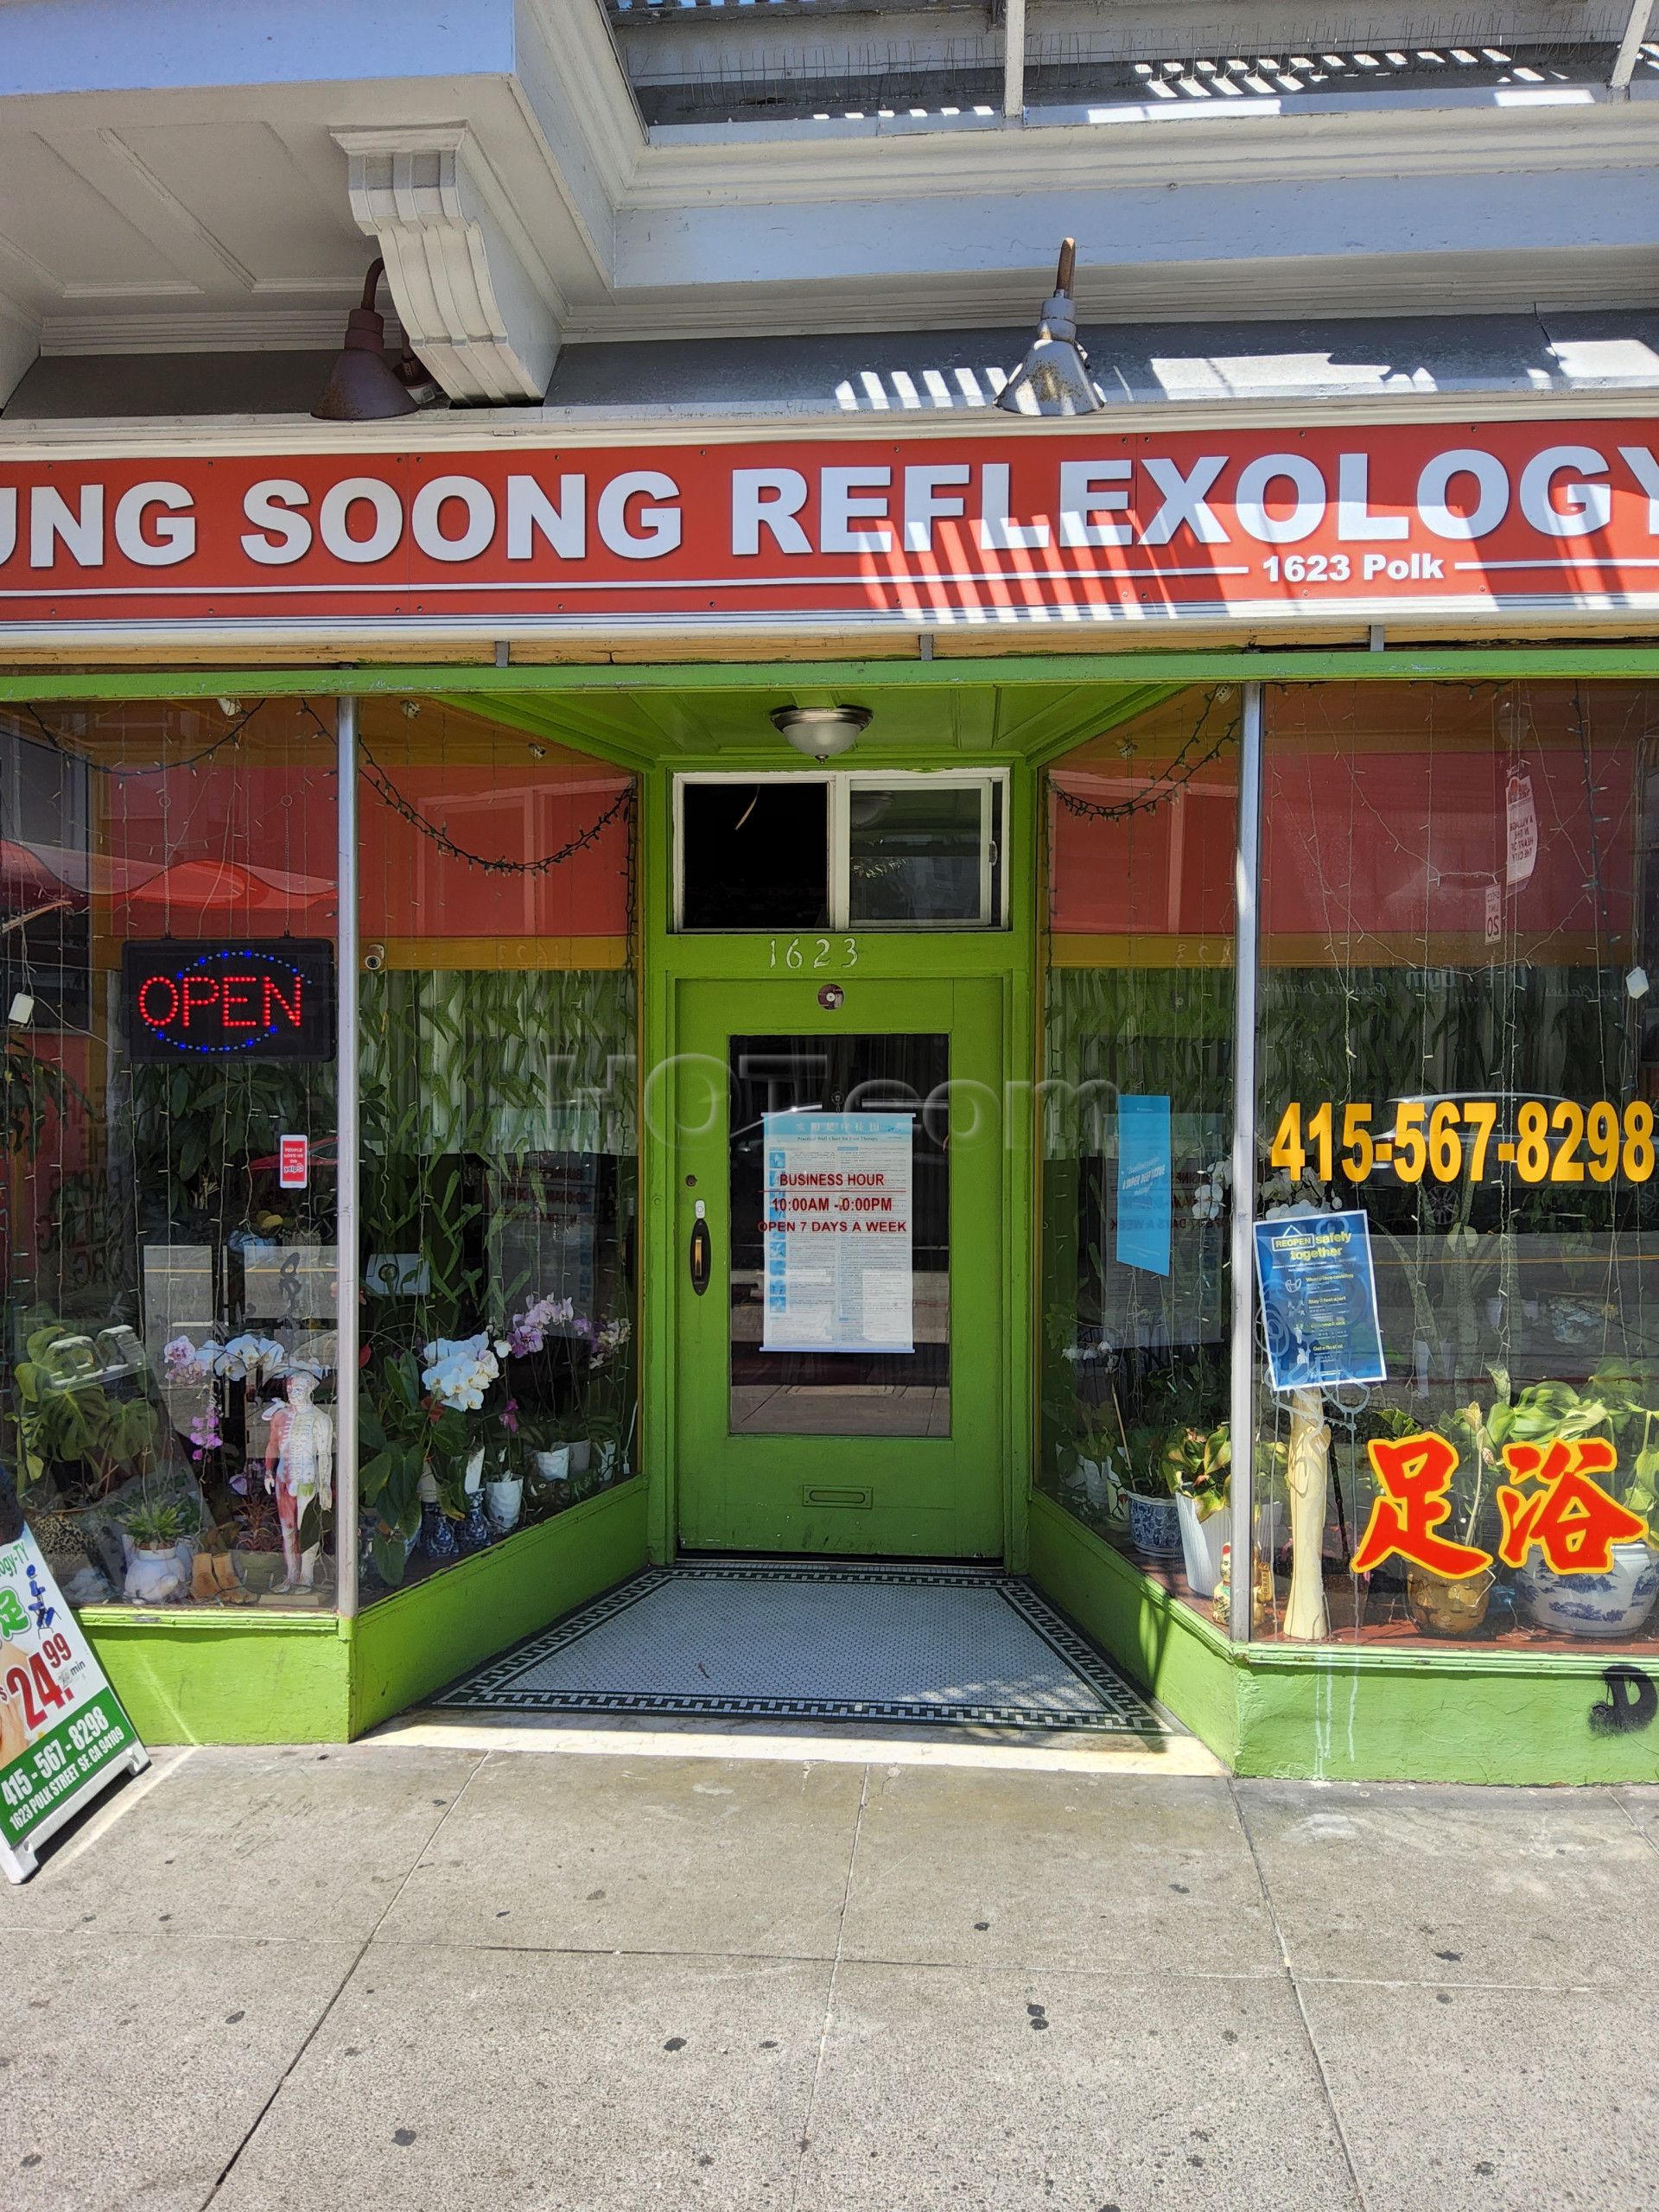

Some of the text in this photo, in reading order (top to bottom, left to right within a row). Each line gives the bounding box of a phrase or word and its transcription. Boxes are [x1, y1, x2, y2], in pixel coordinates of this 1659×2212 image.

[0, 481, 195, 568] NG
[240, 470, 682, 565] SOONG
[1262, 552, 1445, 582] 1623 Polk
[769, 937, 858, 969] 1623
[138, 976, 302, 1028] OPEN
[1271, 1101, 1655, 1183] 415-567-8298
[779, 1173, 885, 1186] BUSINESS HOUR
[772, 1198, 830, 1211] 10:00AM
[757, 1221, 907, 1233] OPEN 7 DAYS A WEEK
[1275, 1231, 1352, 1249] REOPEN safely
[1290, 1246, 1343, 1261] together
[1351, 1431, 1649, 1580] 足浴
[70, 1660, 86, 1676] min
[10, 1803, 34, 1831] 1623
[29, 1785, 54, 1814] POLK
[49, 1763, 80, 1796] STREET
[88, 1745, 104, 1763] CA
[99, 1726, 125, 1754] 94109
